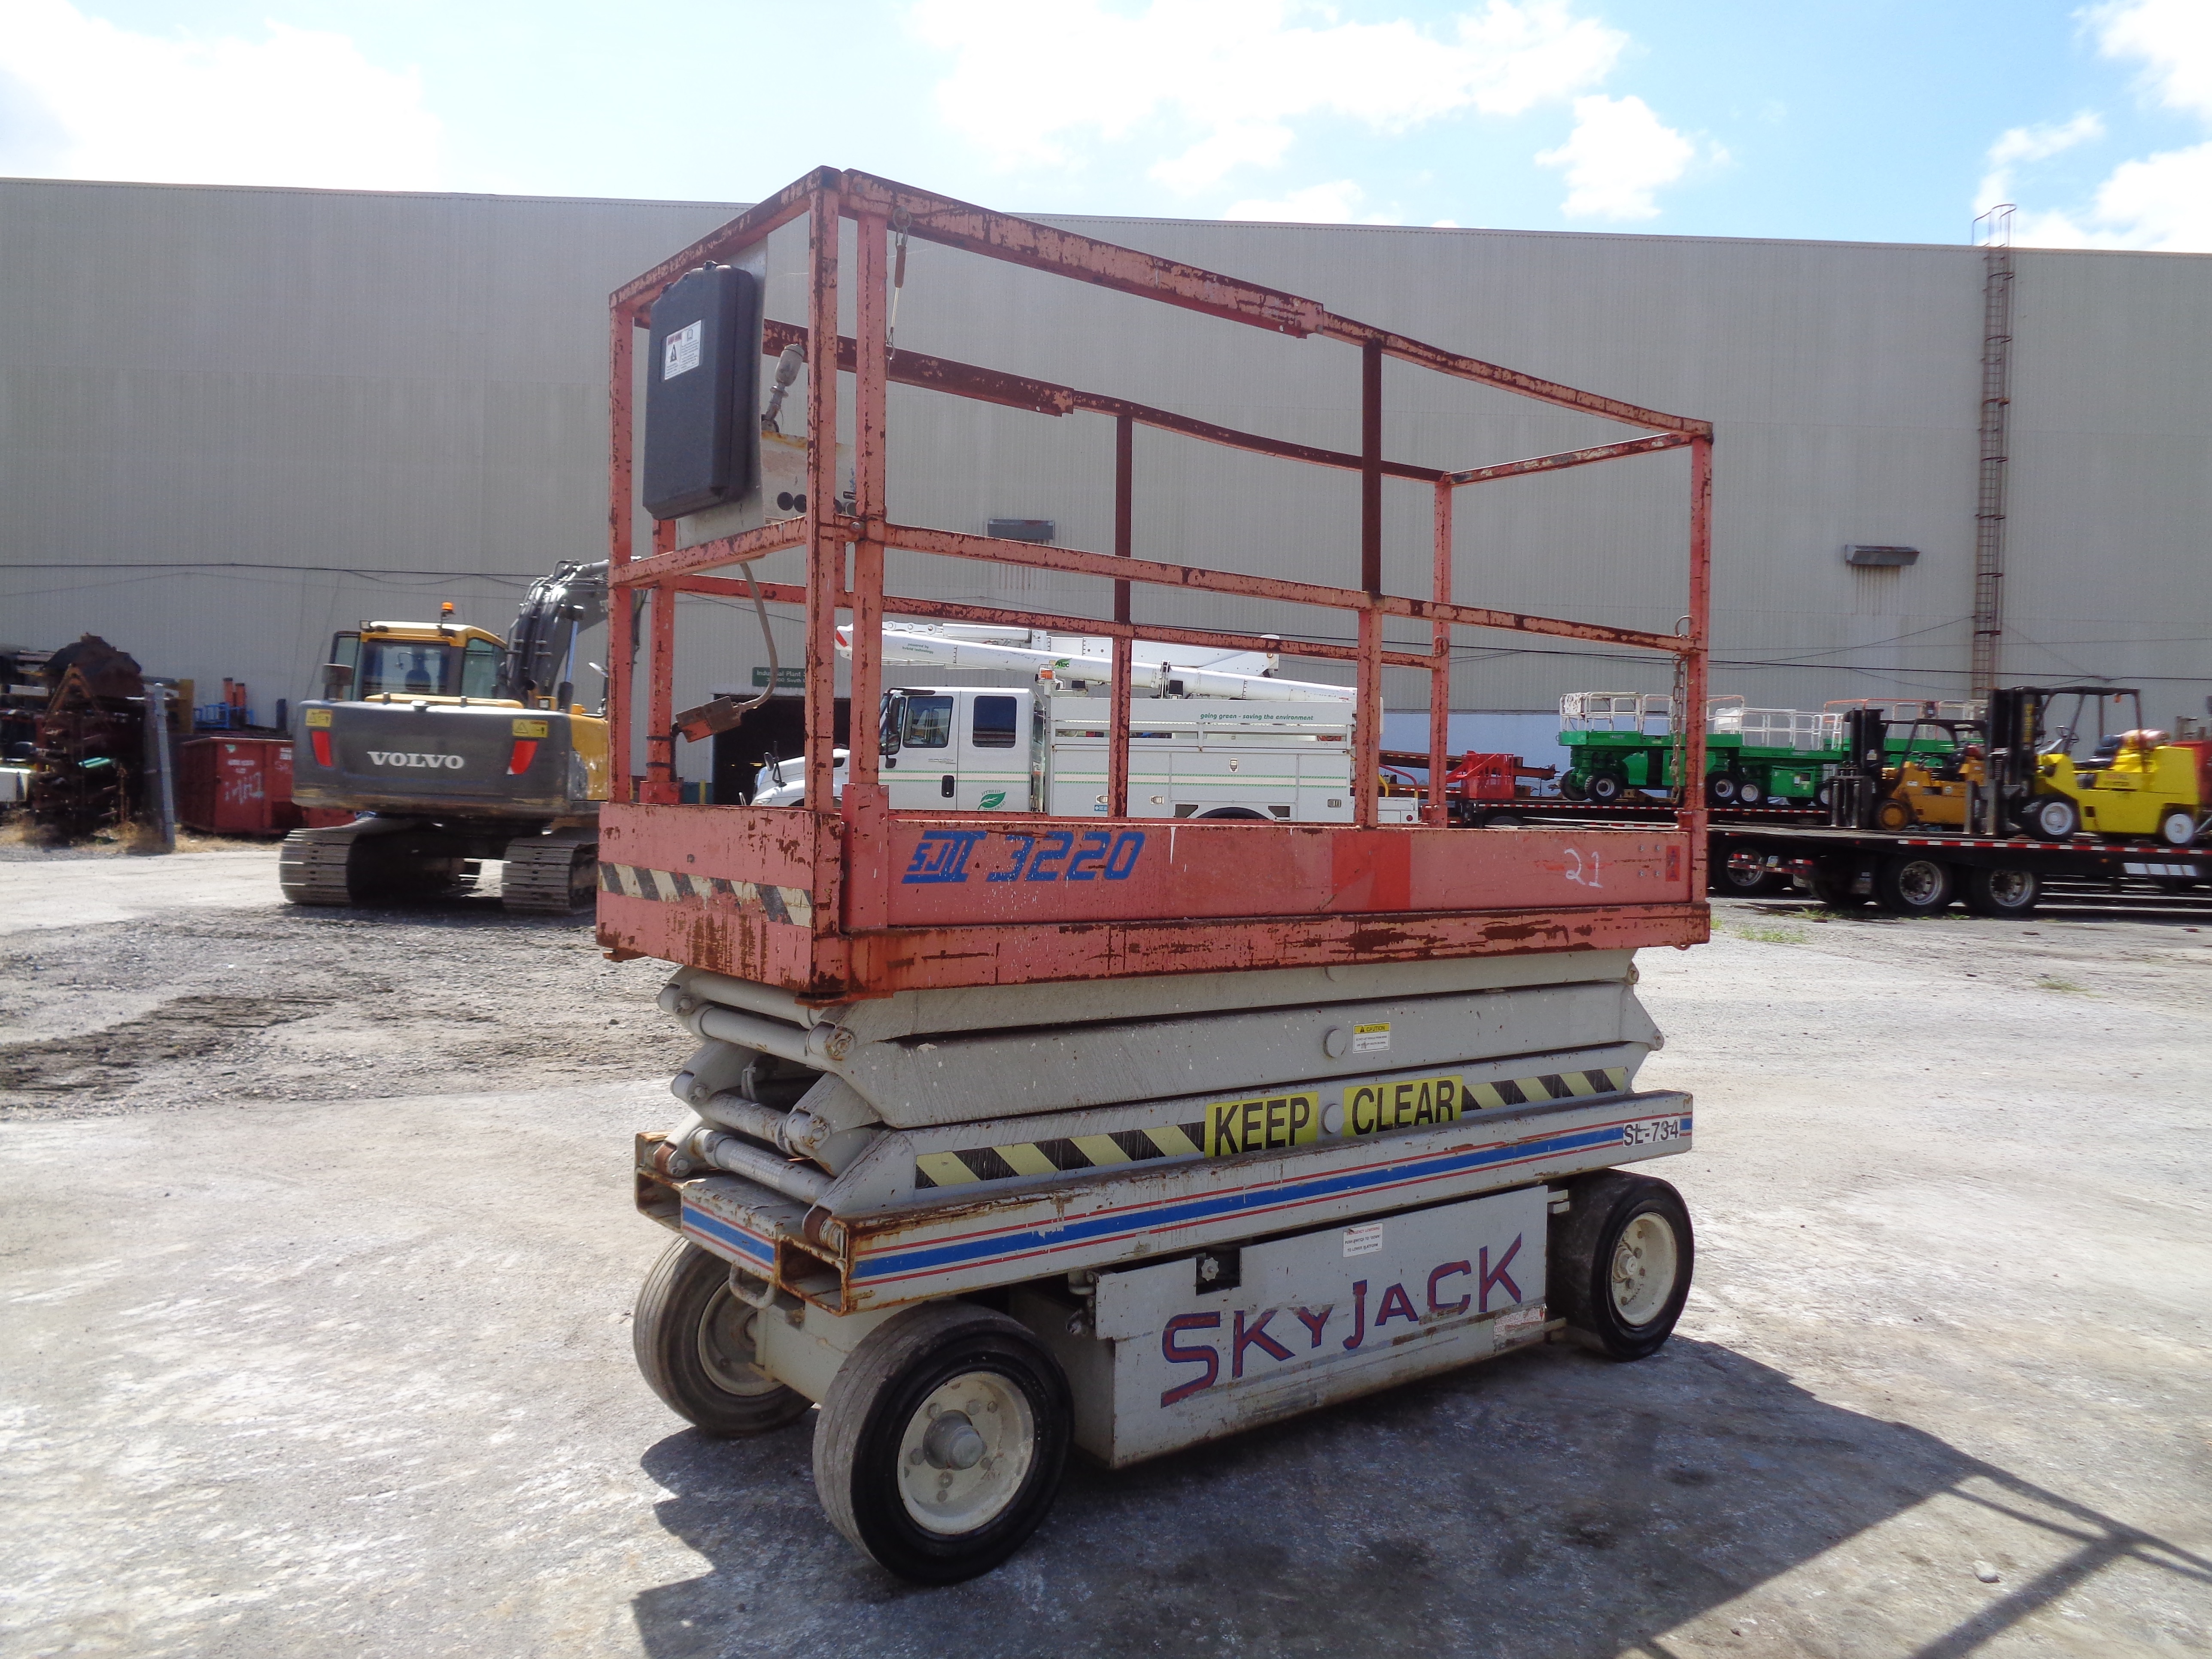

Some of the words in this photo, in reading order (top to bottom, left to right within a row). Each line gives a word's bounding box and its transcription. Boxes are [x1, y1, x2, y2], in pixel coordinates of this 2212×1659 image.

[368, 751, 465, 769] VOLVO
[985, 831, 1146, 882] 3220
[1564, 848, 1603, 888] 21
[1214, 1097, 1310, 1157] KEEP
[1352, 1080, 1455, 1135] CLEAR
[1161, 1232, 1522, 1408] SKYJACK
